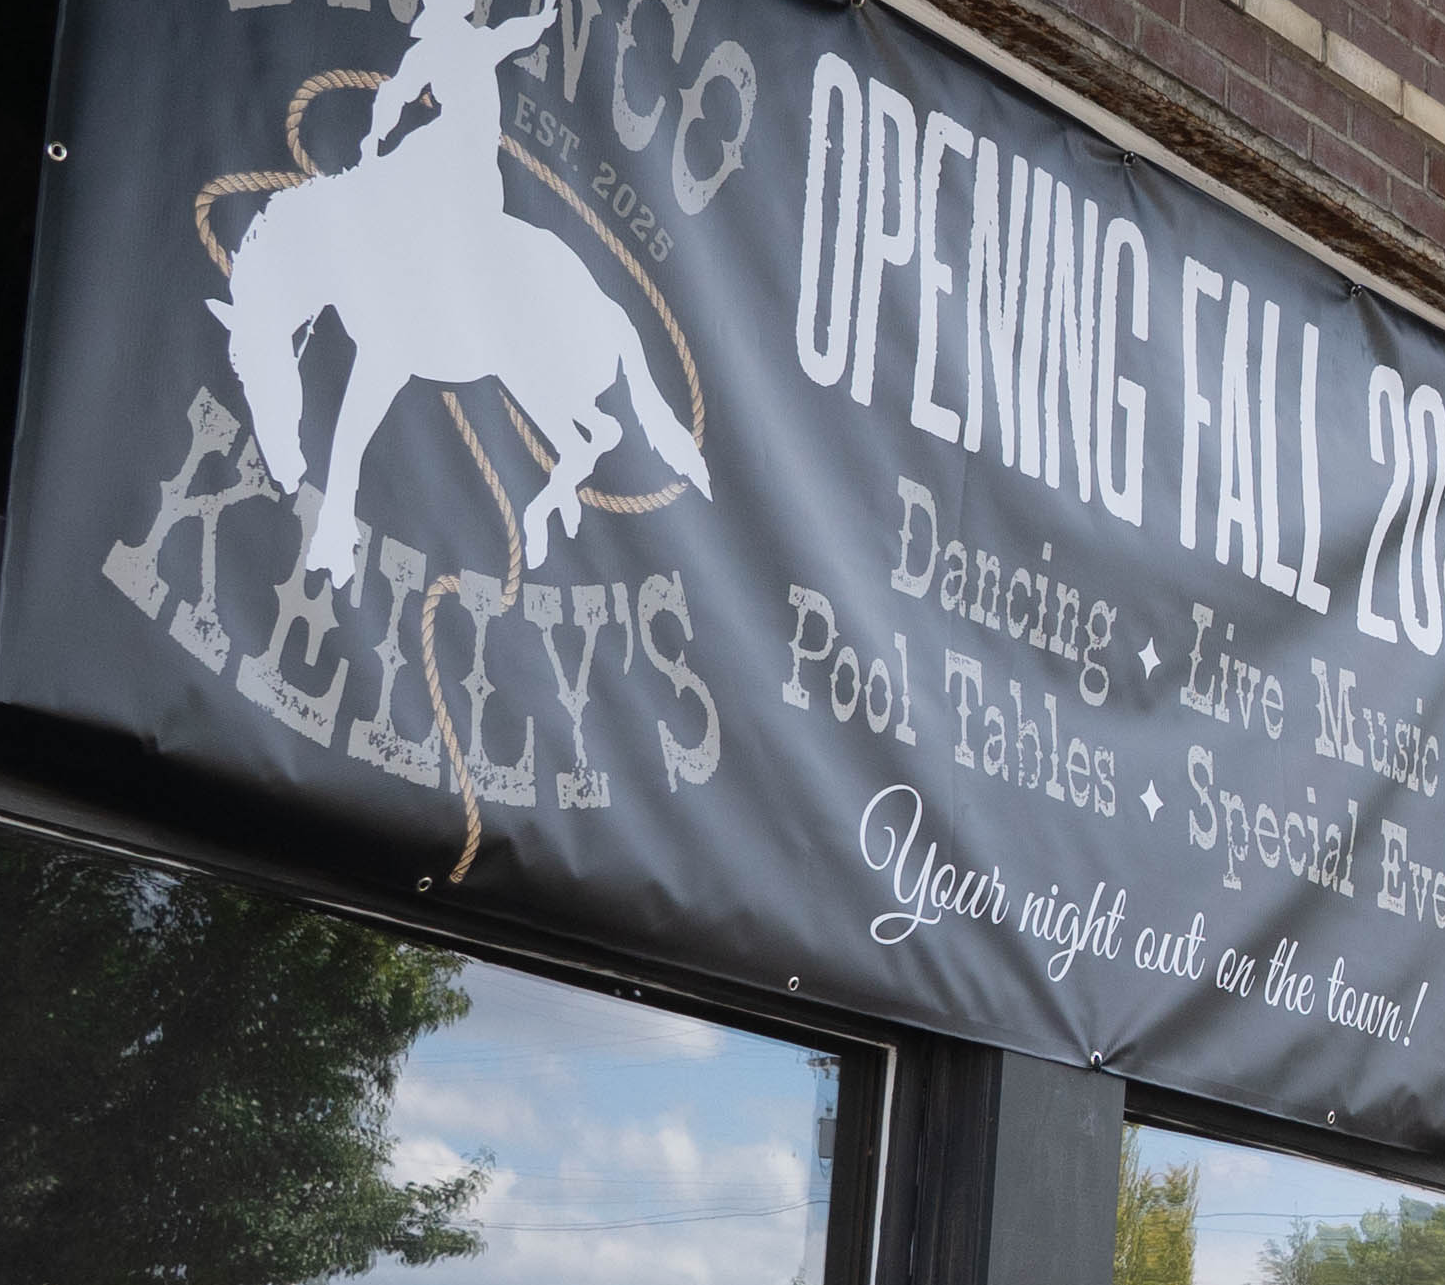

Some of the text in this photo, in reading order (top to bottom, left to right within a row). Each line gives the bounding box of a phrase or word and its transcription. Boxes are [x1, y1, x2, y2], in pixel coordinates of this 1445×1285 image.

[515, 92, 674, 262] EST. 2025
[796, 52, 1149, 527] OPENING
[1180, 256, 1330, 614] FALL
[101, 386, 720, 811] KELLY'S
[781, 583, 917, 746] Pool
[944, 649, 1117, 819] Tables
[1187, 746, 1359, 898] Special
[891, 476, 1441, 798] Dancing Live Music
[858, 784, 1429, 1048] Your night out on the town!
